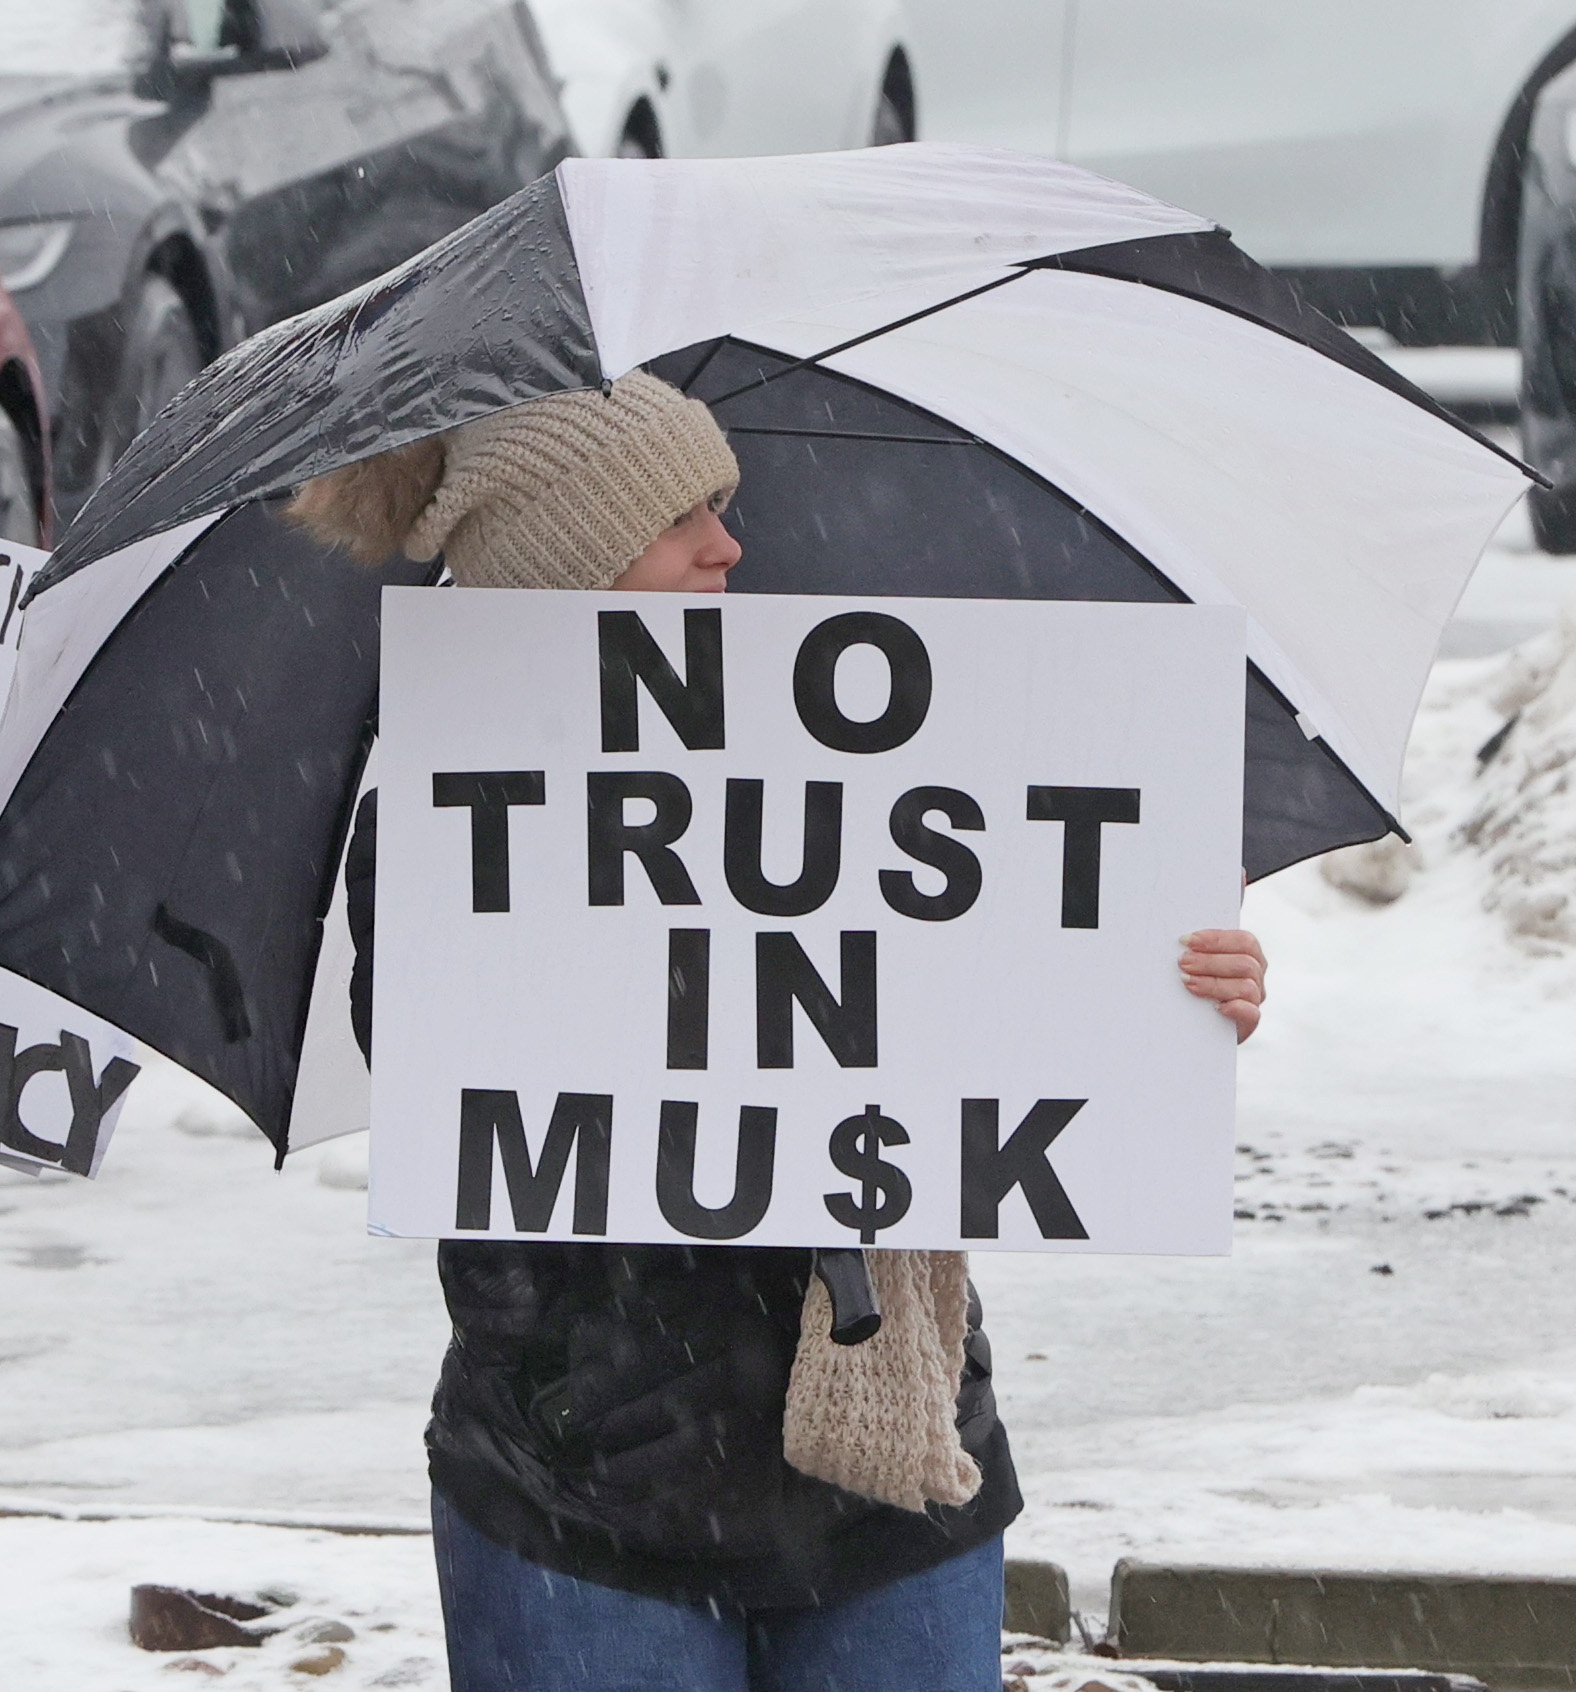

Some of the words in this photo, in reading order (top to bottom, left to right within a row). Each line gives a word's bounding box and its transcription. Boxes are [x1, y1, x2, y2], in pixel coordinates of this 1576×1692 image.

[597, 607, 933, 754] NO
[432, 770, 1142, 929] TRUST
[666, 928, 879, 1071] IN
[454, 1088, 1091, 1244] MU$K
